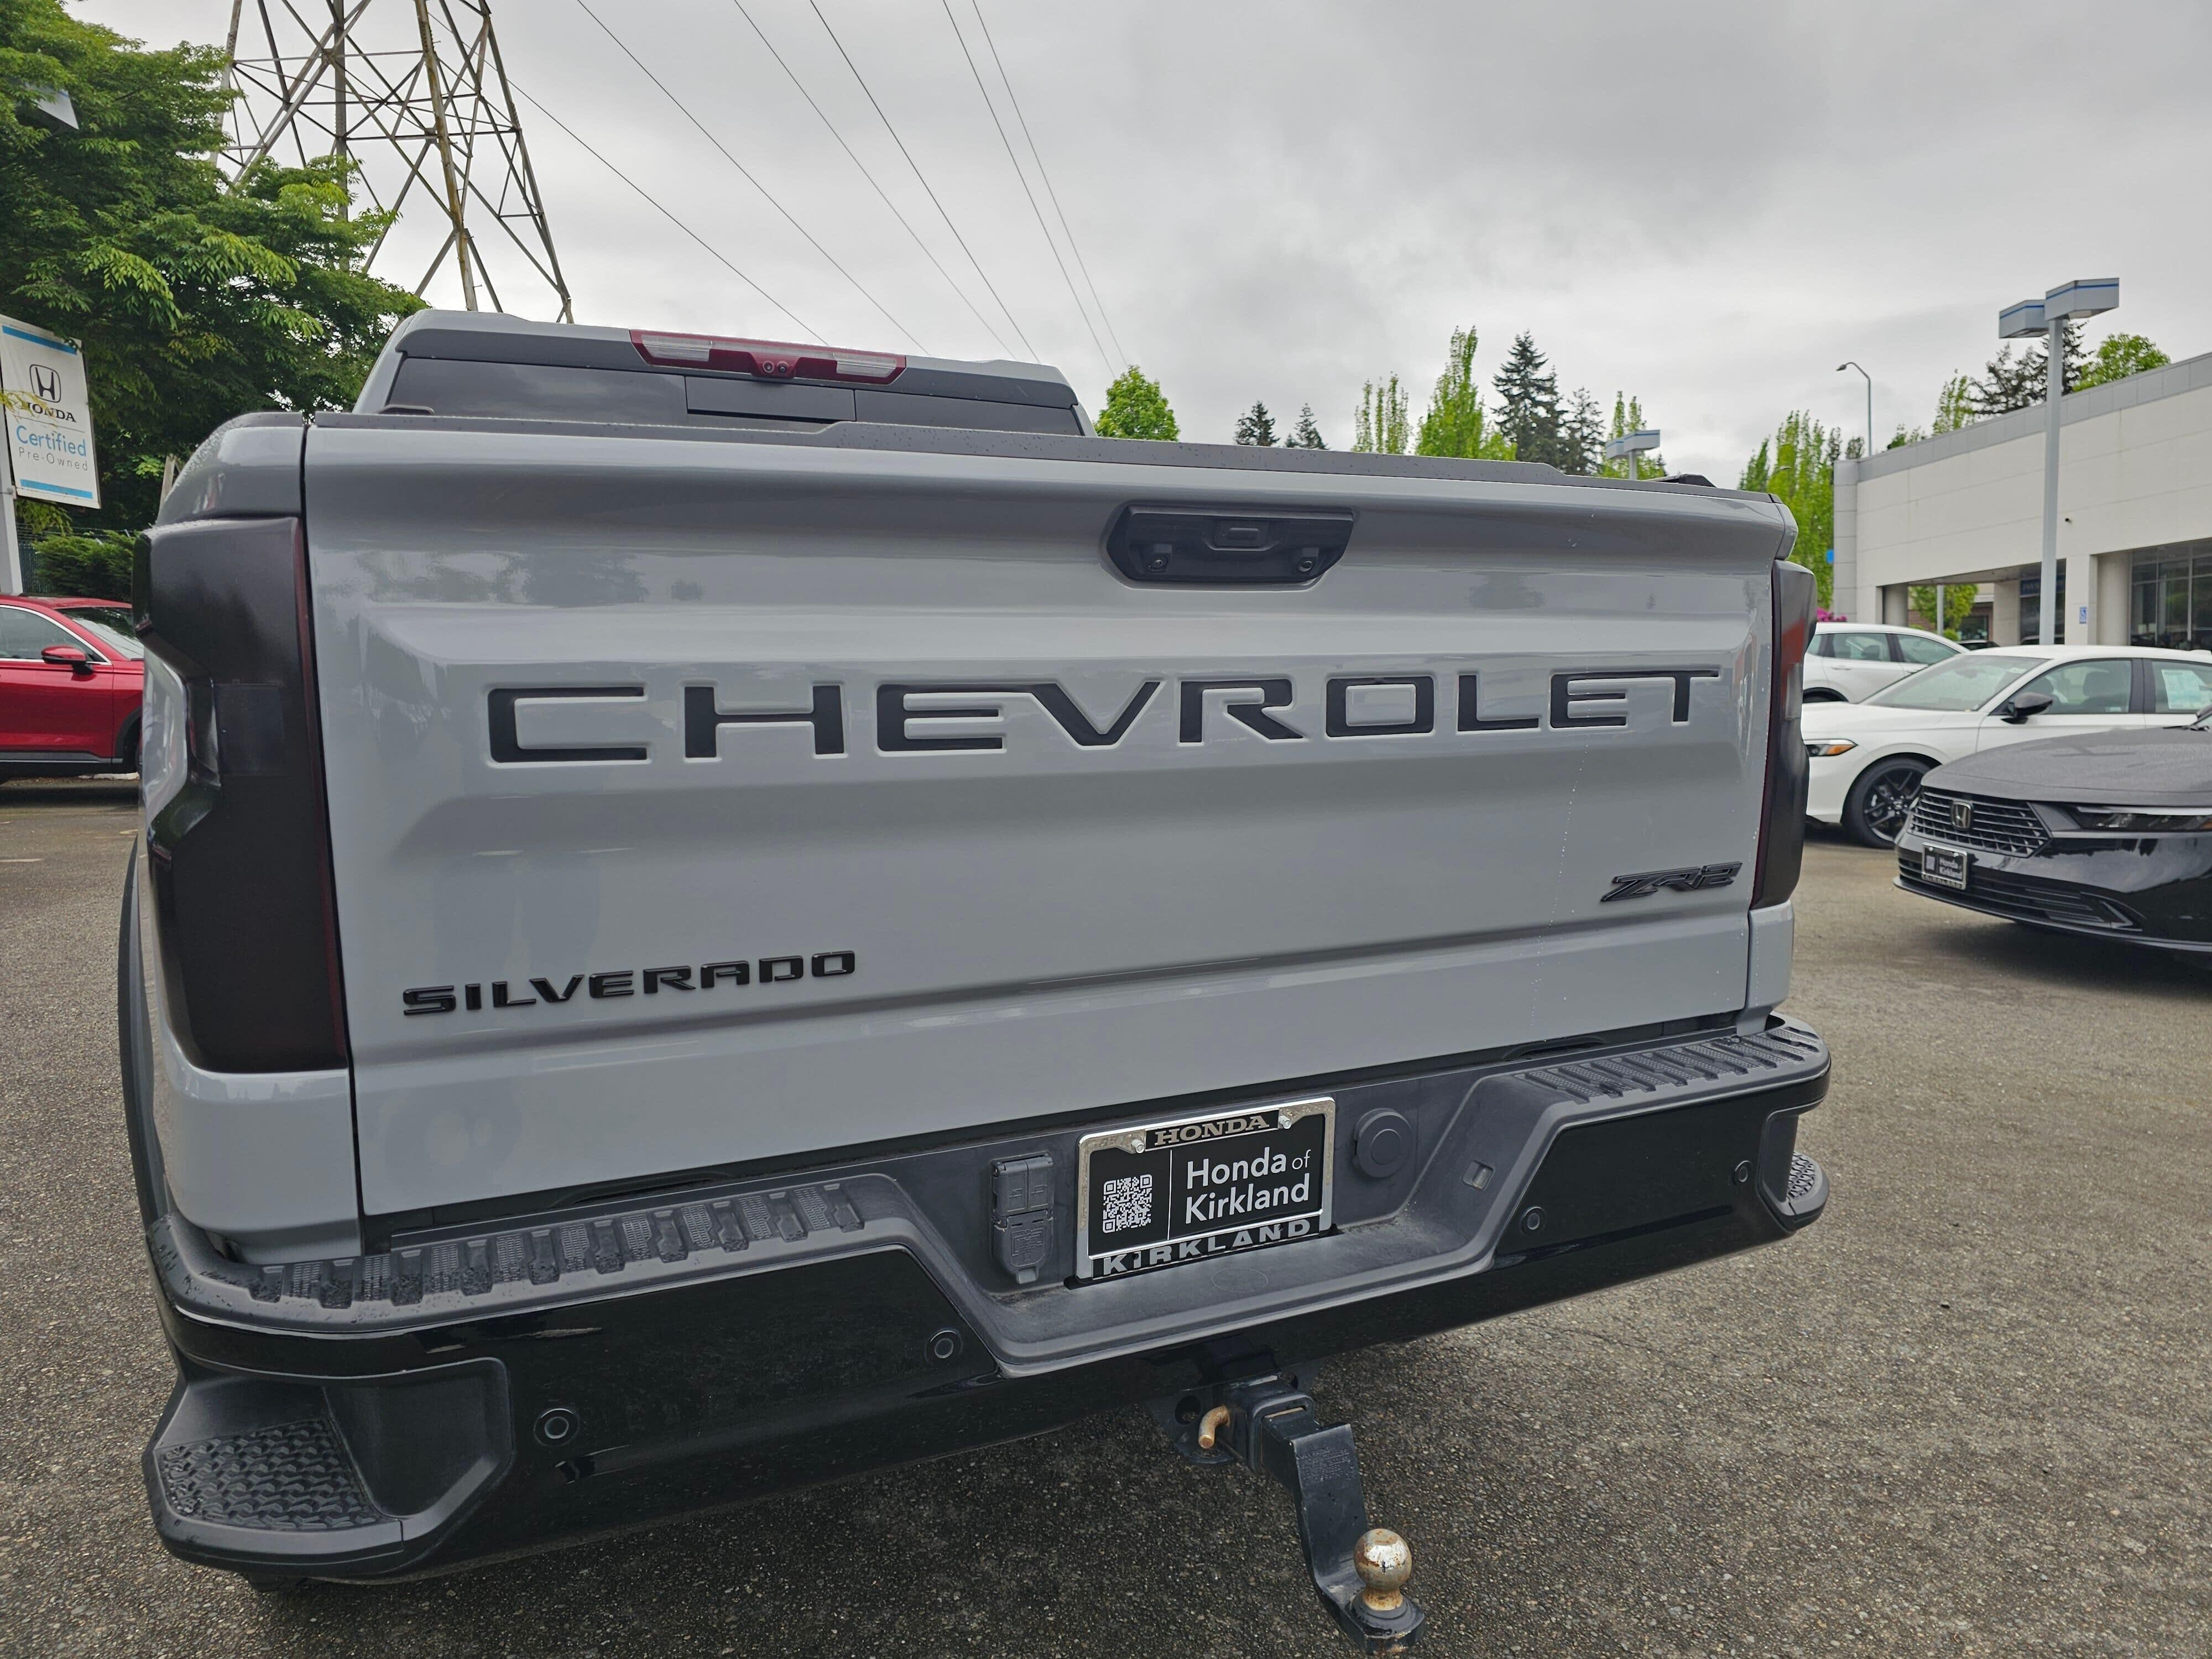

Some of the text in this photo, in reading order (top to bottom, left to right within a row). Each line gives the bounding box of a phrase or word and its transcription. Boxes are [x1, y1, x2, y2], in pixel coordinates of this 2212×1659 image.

[16, 425, 87, 457] Certified
[19, 446, 88, 471] Pre-Owned
[487, 669, 1720, 763] CHEVROLET
[1601, 861, 1743, 902] ZR2
[403, 950, 855, 1016] SILVERADO
[1154, 1115, 1269, 1146] HONDA
[1187, 1146, 1312, 1190] Honda of
[1185, 1173, 1310, 1224] Kirkland
[1103, 1219, 1311, 1275] KIRKLAND
